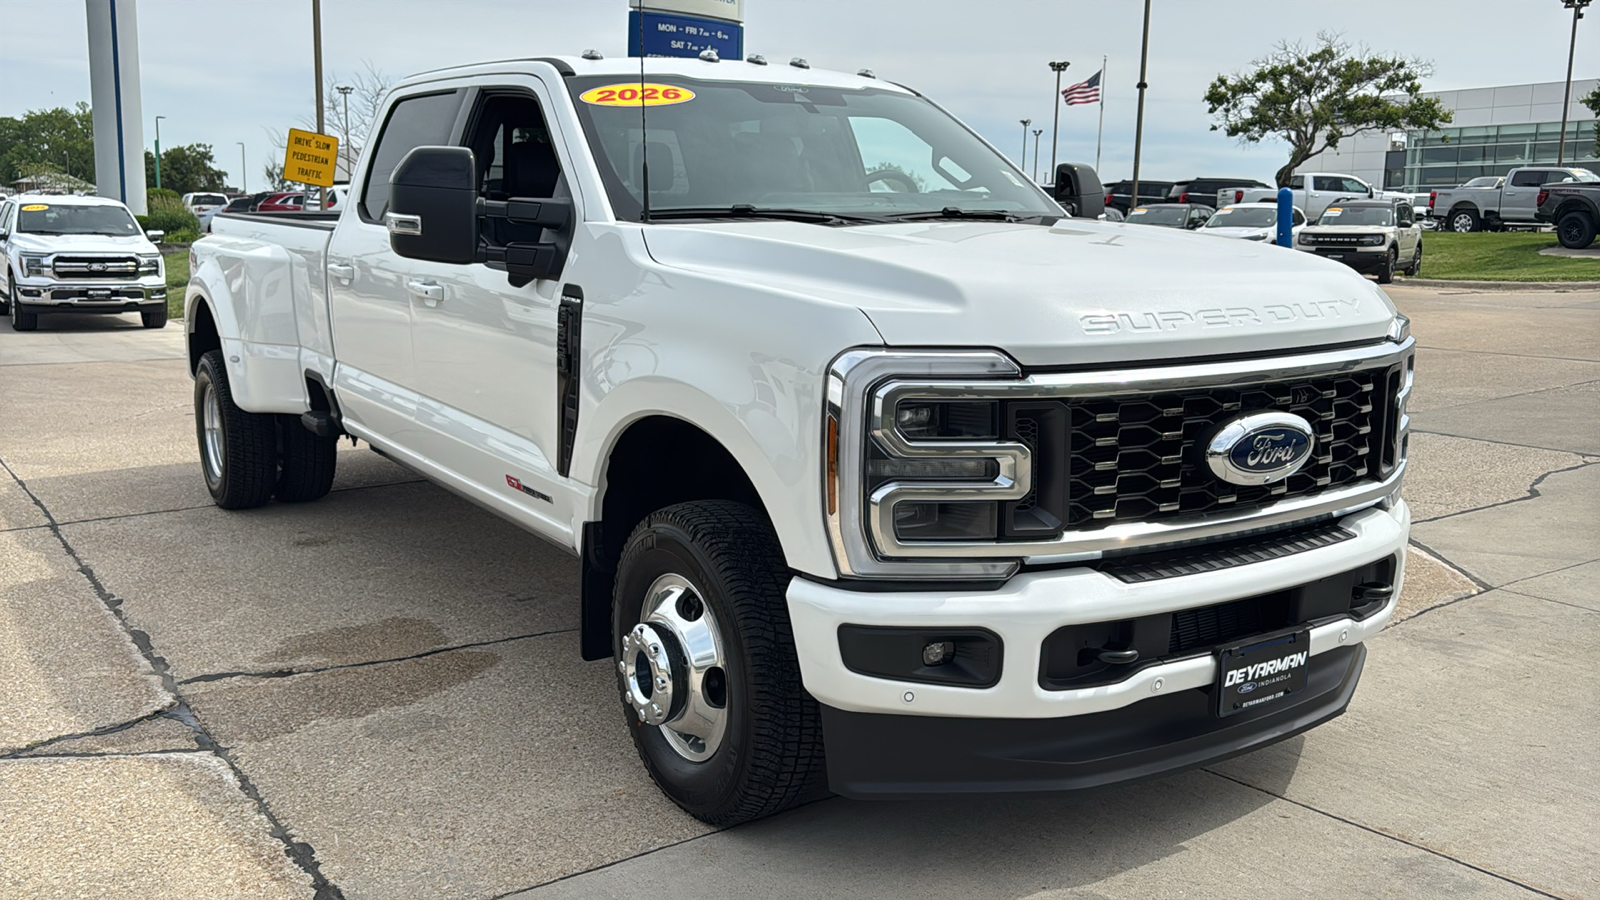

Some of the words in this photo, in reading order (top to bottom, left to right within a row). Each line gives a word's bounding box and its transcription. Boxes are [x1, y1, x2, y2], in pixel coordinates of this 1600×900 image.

[657, 23, 676, 32] MON
[685, 26, 697, 35] FRI
[671, 40, 685, 49] SAT
[595, 88, 682, 102] 2026
[294, 136, 312, 148] DRIVE
[315, 140, 331, 151] SLOW
[292, 151, 329, 165] PEDESTRIAN
[297, 167, 322, 179] TRAFFIC
[1079, 307, 1262, 336] SUPER
[1264, 298, 1361, 324] DUTY
[1247, 434, 1297, 467] Ford
[1224, 651, 1307, 687] DEYARMAN
[1258, 673, 1291, 687] INDIANOLA
